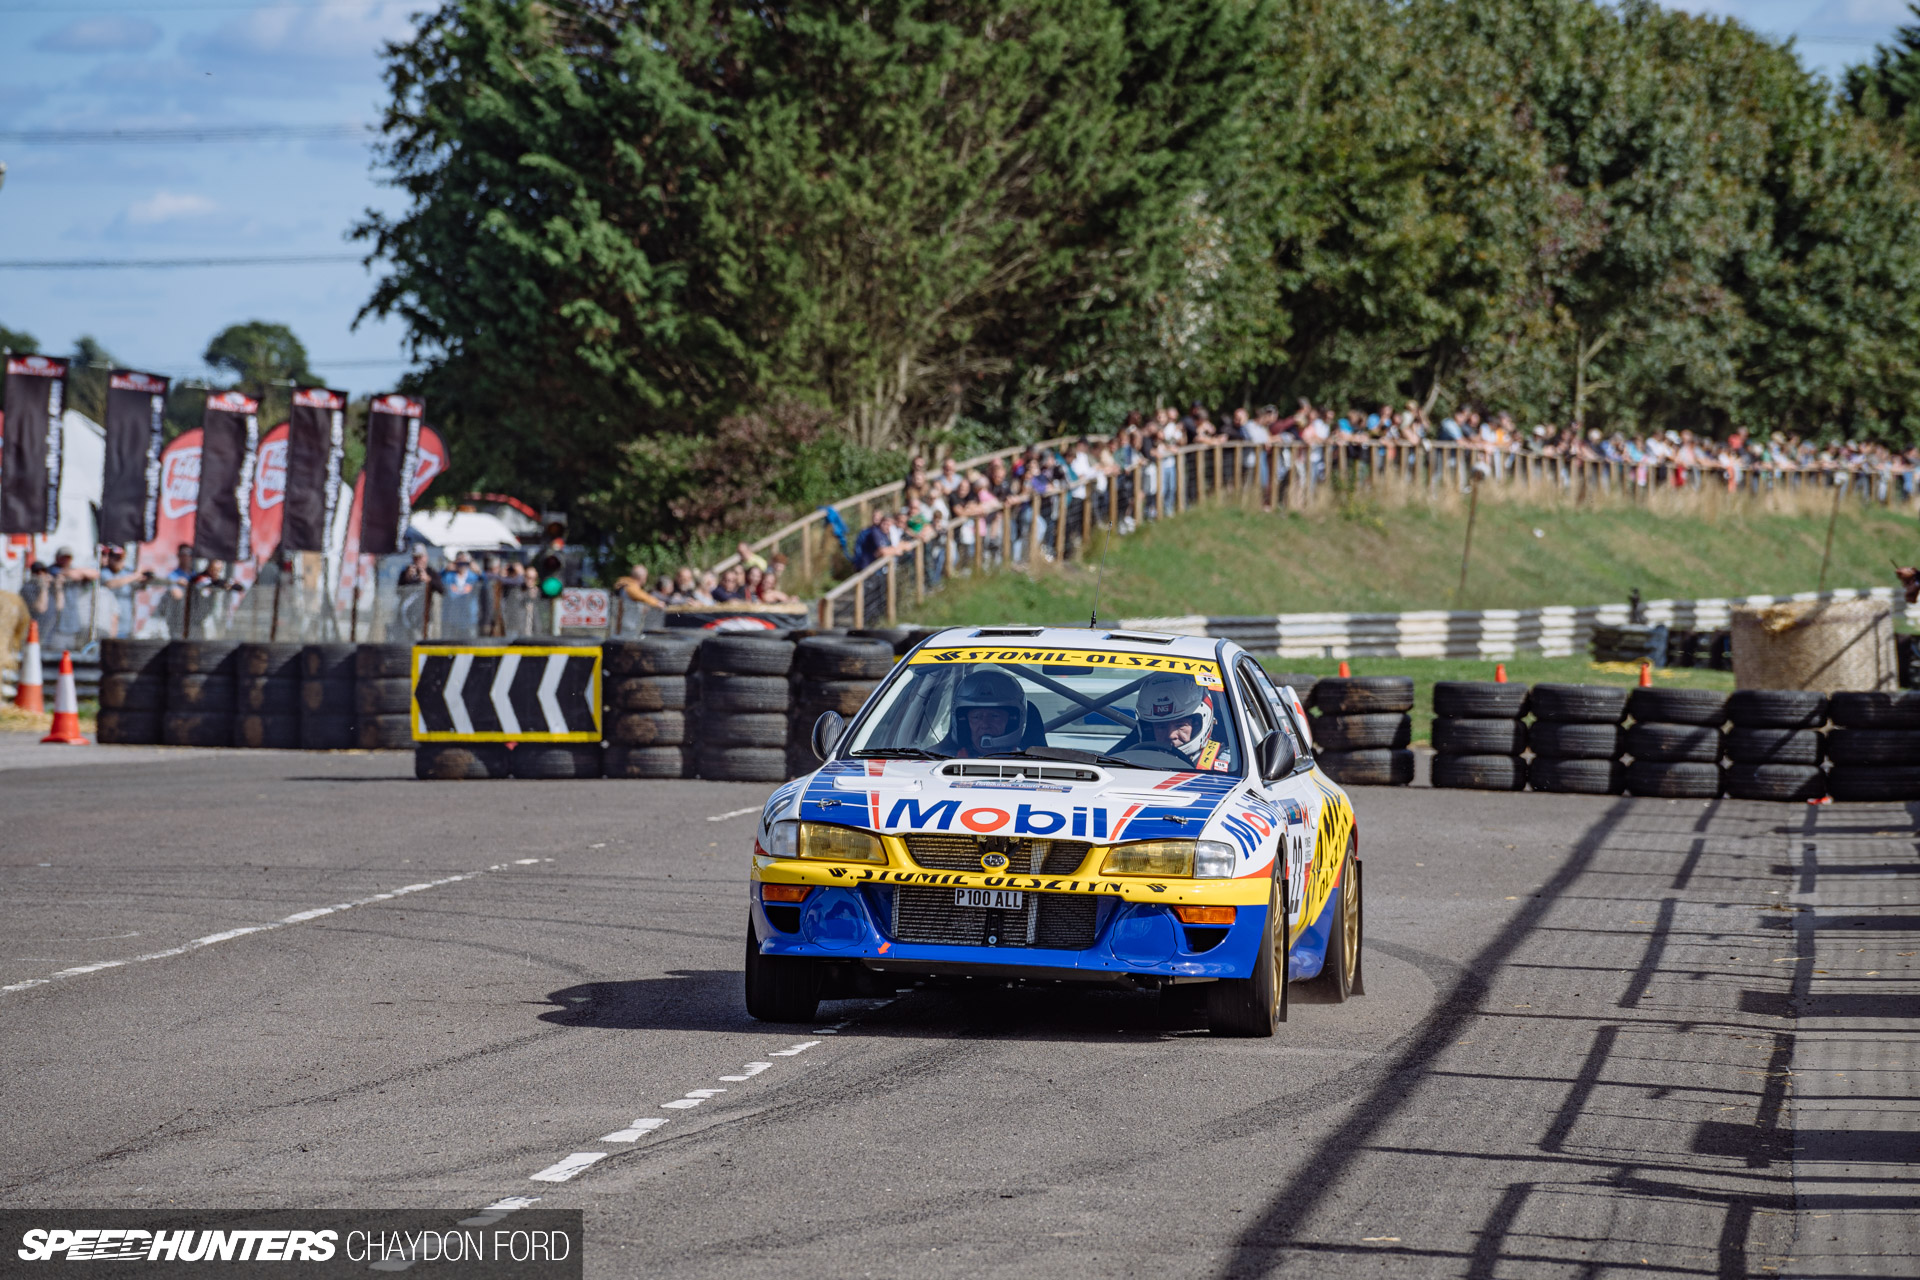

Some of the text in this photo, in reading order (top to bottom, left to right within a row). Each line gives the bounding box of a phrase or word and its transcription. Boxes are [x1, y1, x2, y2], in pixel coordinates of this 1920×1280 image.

[961, 651, 1214, 673] STOMIL-OLSZTYN
[885, 799, 1107, 839] Mobil
[1220, 793, 1281, 860] Mobil
[956, 889, 1021, 908] P100 ALL
